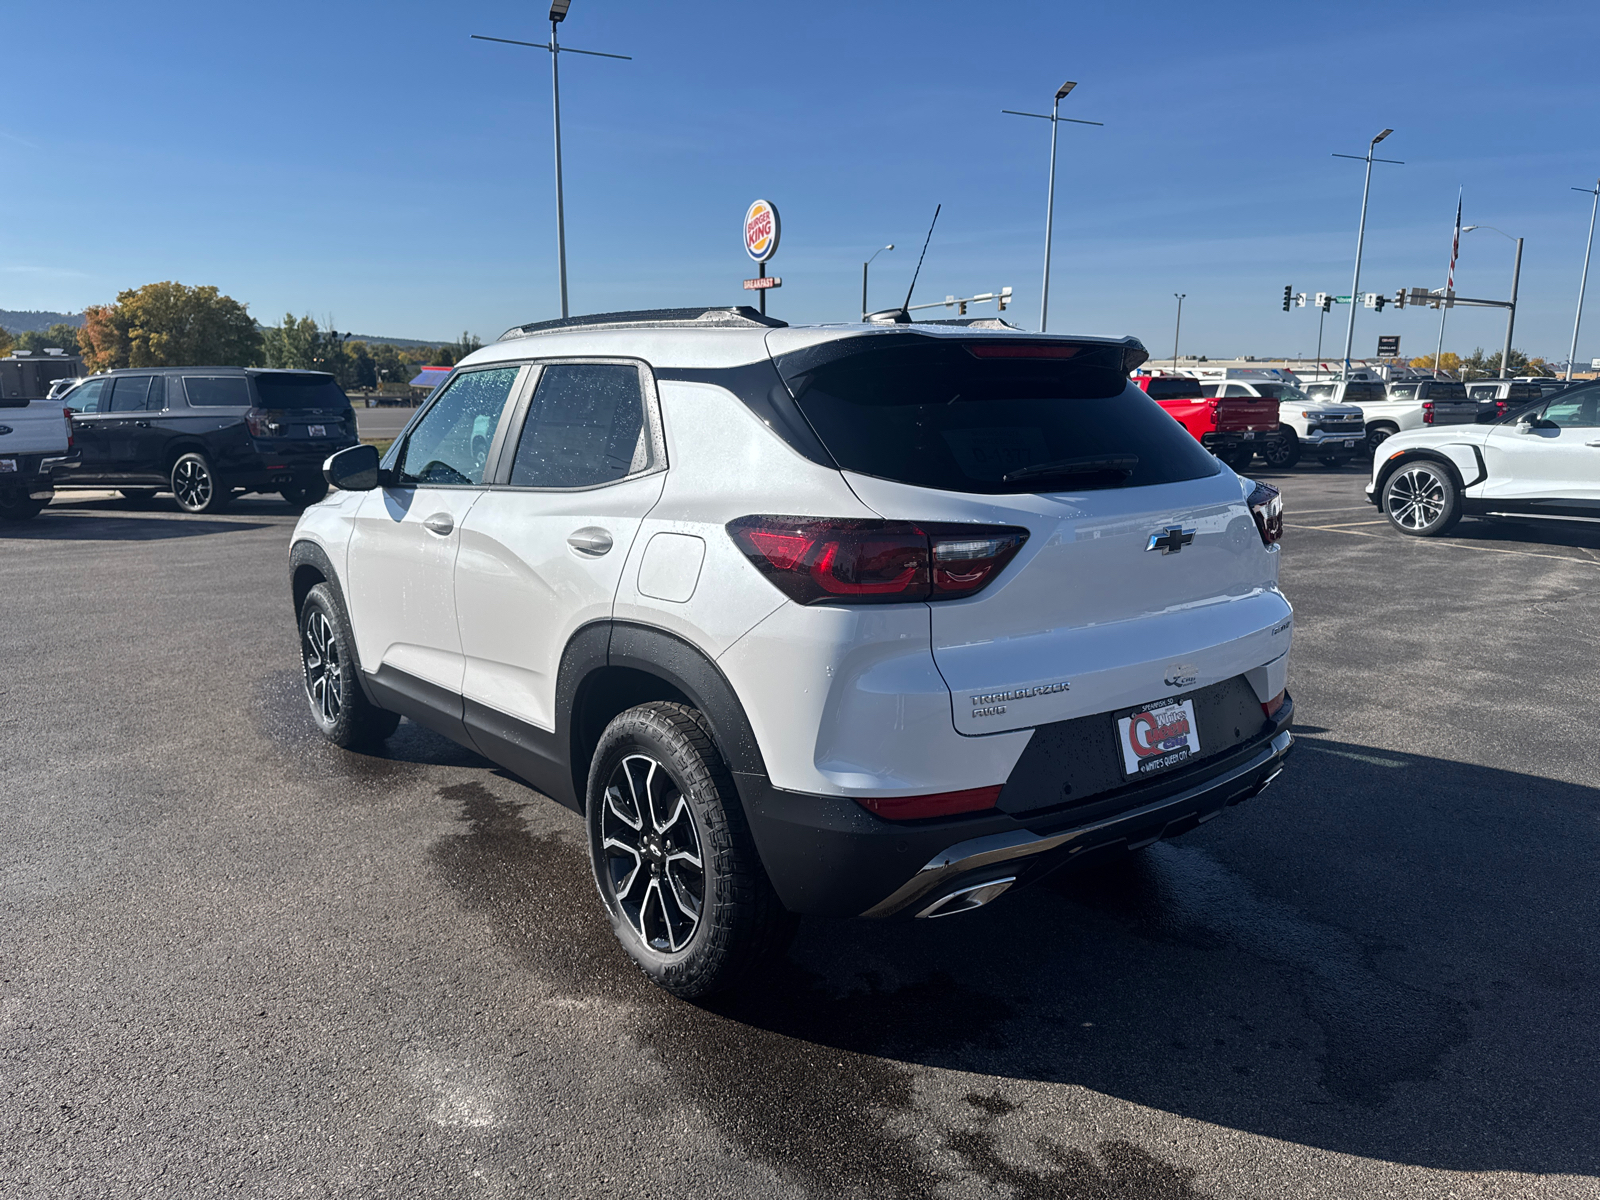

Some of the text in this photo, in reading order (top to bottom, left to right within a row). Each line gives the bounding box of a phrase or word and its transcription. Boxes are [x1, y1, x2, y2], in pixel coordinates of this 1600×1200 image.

[747, 210, 771, 234] BURGER
[748, 220, 772, 248] KING
[743, 277, 774, 290] BREAKFAST
[970, 682, 1070, 705] TRAILBLAZER
[972, 705, 1007, 718] AWD
[1129, 712, 1190, 757] Queen
[1145, 750, 1188, 772] WHITE'S QUEEN CITY
